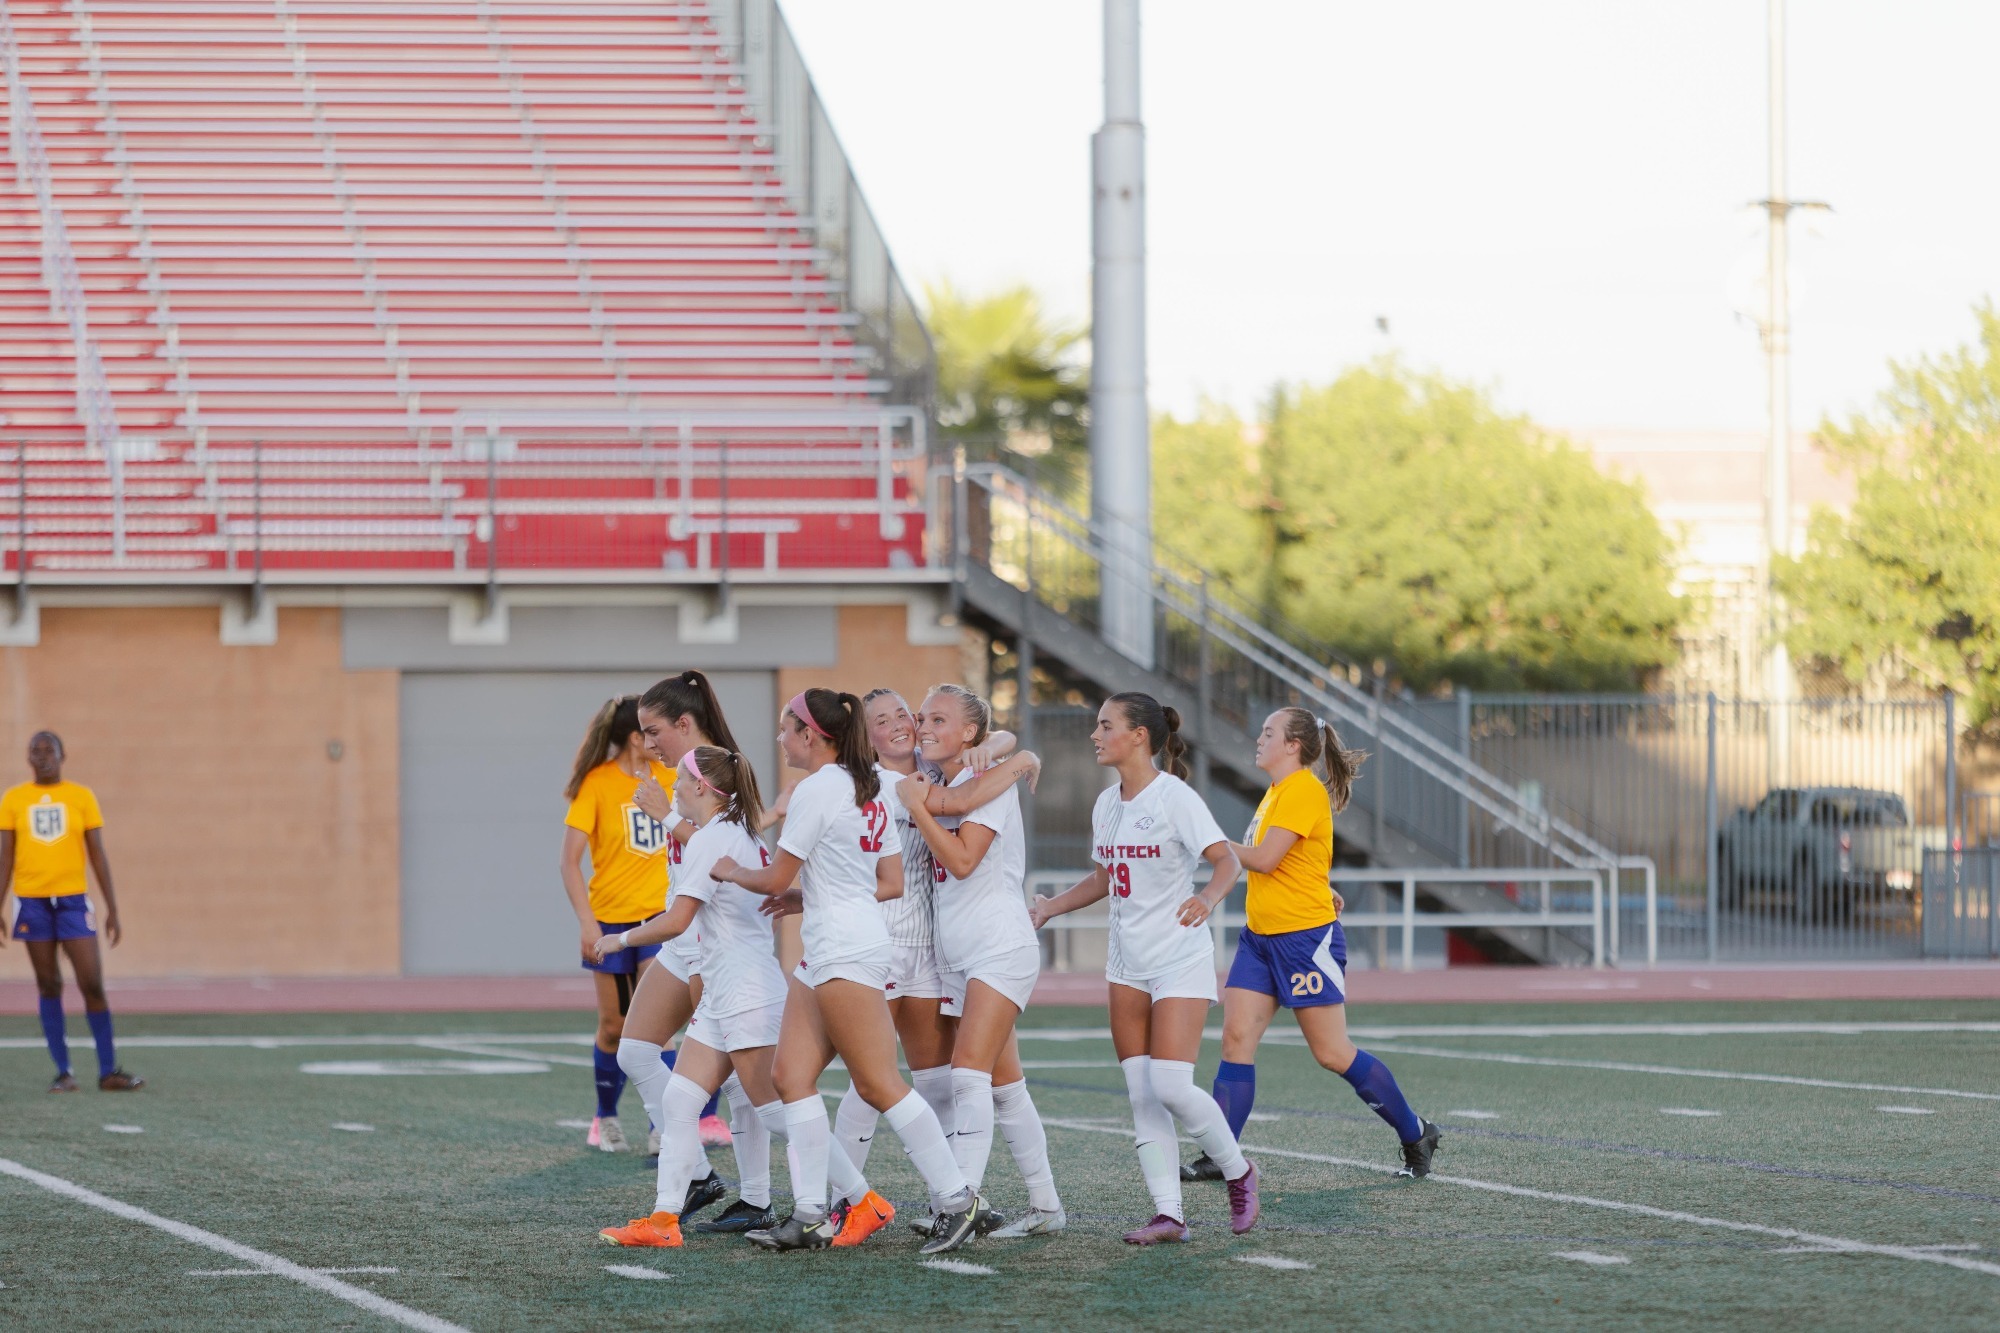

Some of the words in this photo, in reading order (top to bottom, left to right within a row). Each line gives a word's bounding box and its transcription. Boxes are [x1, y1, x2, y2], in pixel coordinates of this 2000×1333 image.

[860, 800, 887, 852] 32
[1117, 845, 1160, 858] TECH
[1107, 863, 1131, 898] 19
[1291, 971, 1323, 996] 20
